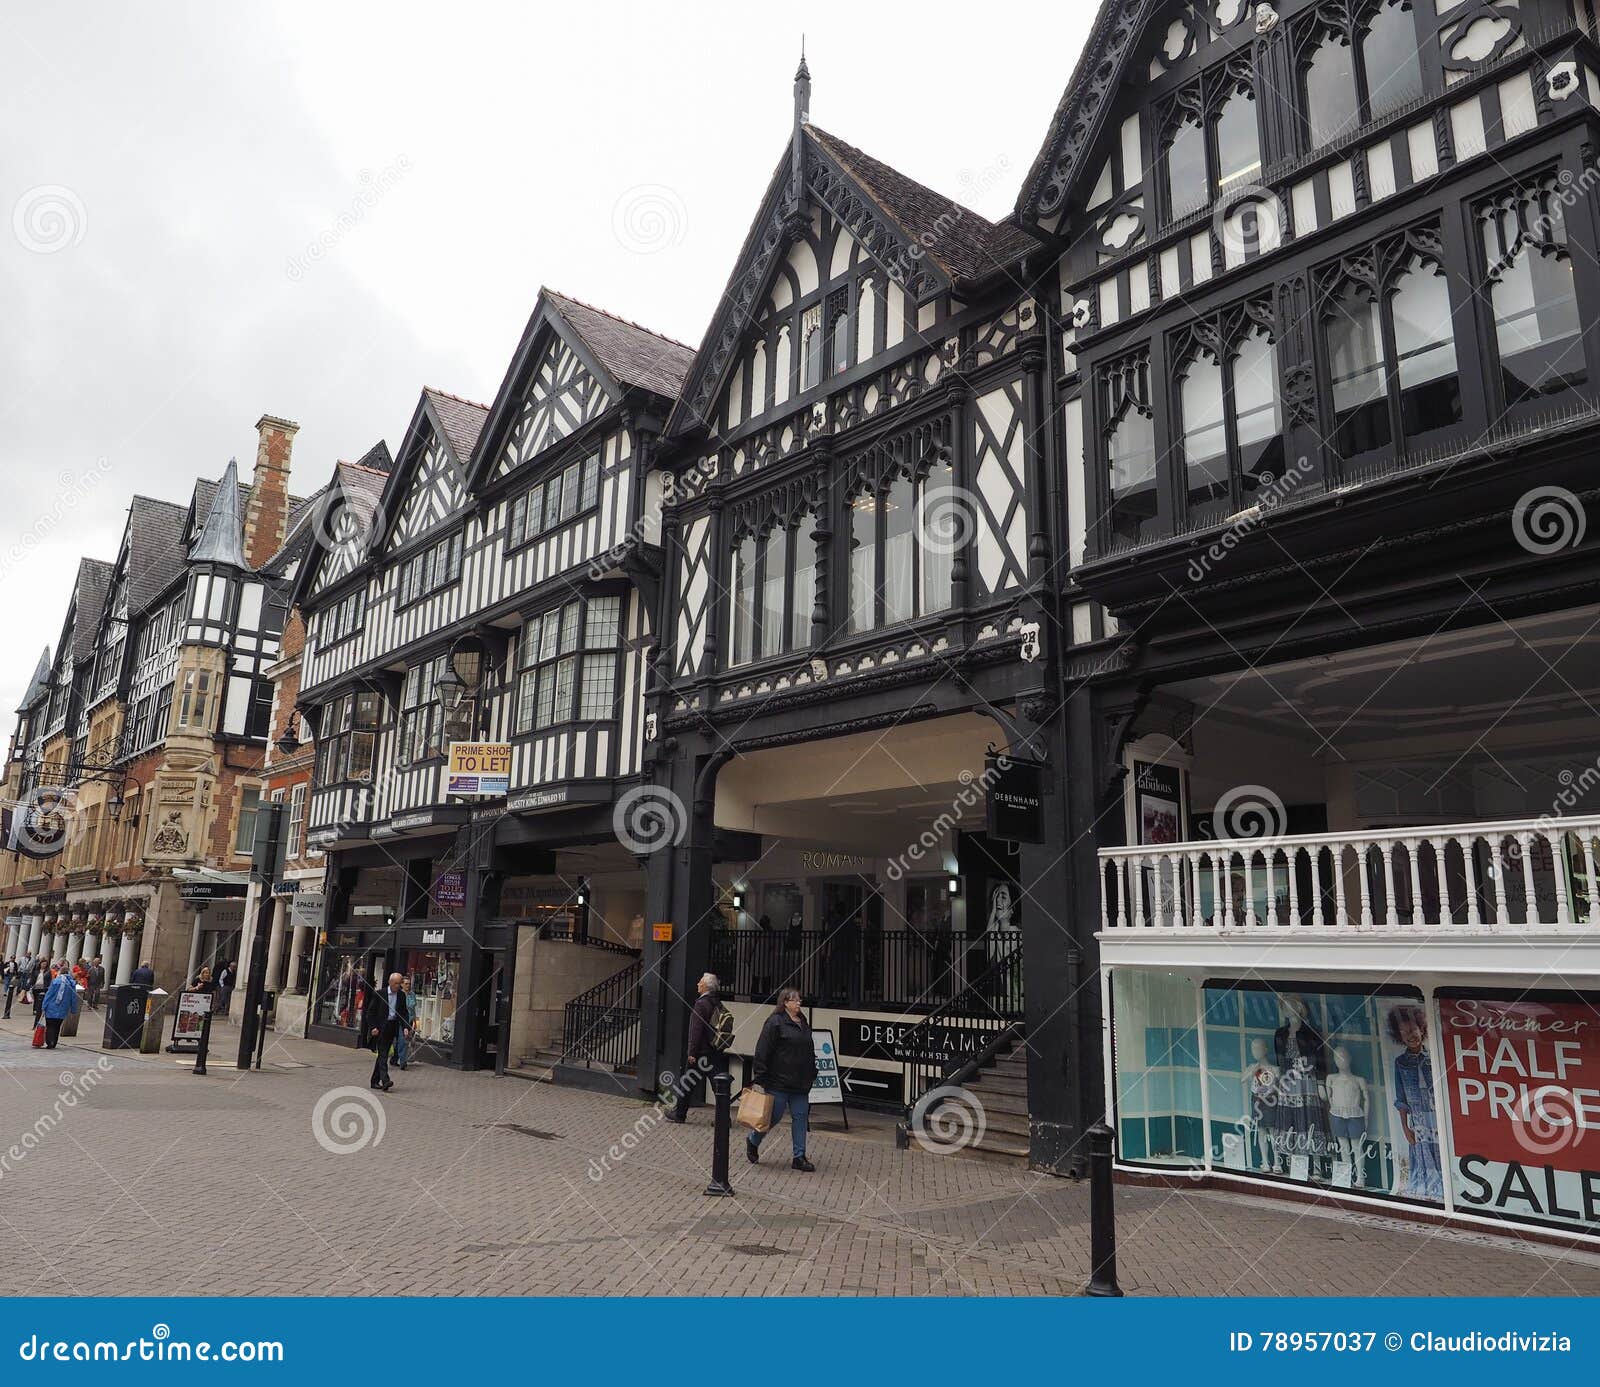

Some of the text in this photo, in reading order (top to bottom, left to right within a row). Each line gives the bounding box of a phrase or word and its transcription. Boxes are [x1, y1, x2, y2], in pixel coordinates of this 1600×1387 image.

[455, 746, 511, 756] PRIME SHOP
[457, 757, 509, 771] TO LET
[1137, 775, 1173, 793] fabulous
[994, 792, 1039, 807] DEBENHAMS
[1450, 1000, 1588, 1035] Summer
[1453, 1034, 1582, 1080] HALF
[1458, 1077, 1600, 1130] PRICE
[1458, 1154, 1600, 1222] SALE
